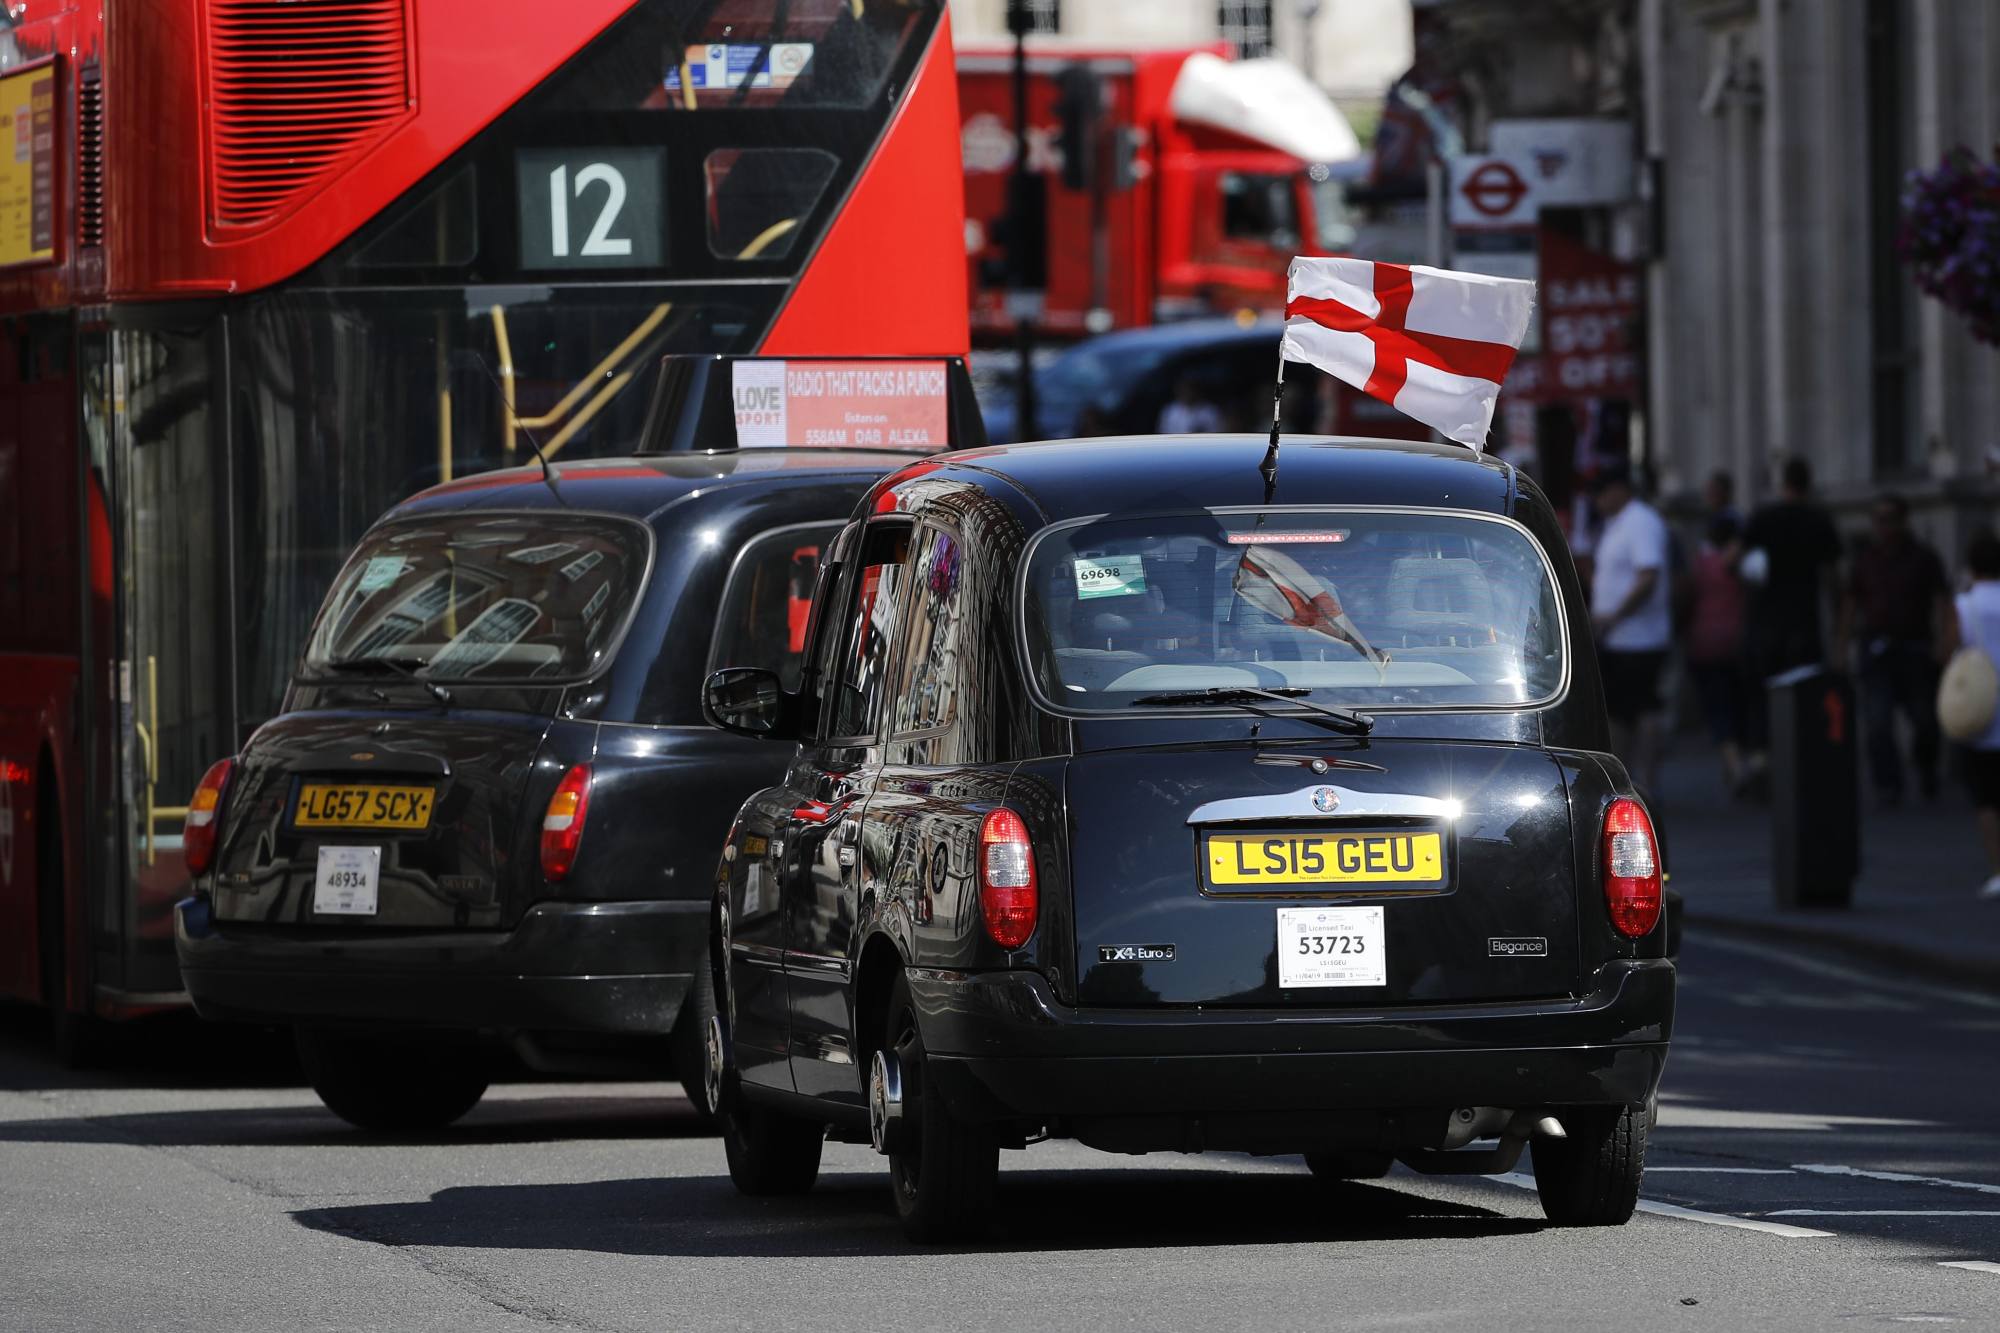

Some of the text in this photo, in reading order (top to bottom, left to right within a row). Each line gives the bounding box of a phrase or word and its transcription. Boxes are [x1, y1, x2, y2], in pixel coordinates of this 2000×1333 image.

[550, 162, 632, 257] 12
[787, 370, 945, 396] RADIO THAT PACKS A PUNCH
[736, 386, 780, 410] LOVE
[736, 412, 780, 425] SPORT
[855, 429, 882, 444] DAB
[888, 429, 929, 444] ALEXA
[1081, 567, 1120, 580] 69698
[307, 790, 423, 822] LG57 SCX
[1236, 836, 1414, 875] LS15 GEU
[327, 871, 367, 888] 48934
[1309, 924, 1339, 932] Licensed
[1101, 947, 1173, 960] TX4 Euro 5
[1299, 936, 1365, 955] 53723
[1492, 940, 1543, 954] Elegance
